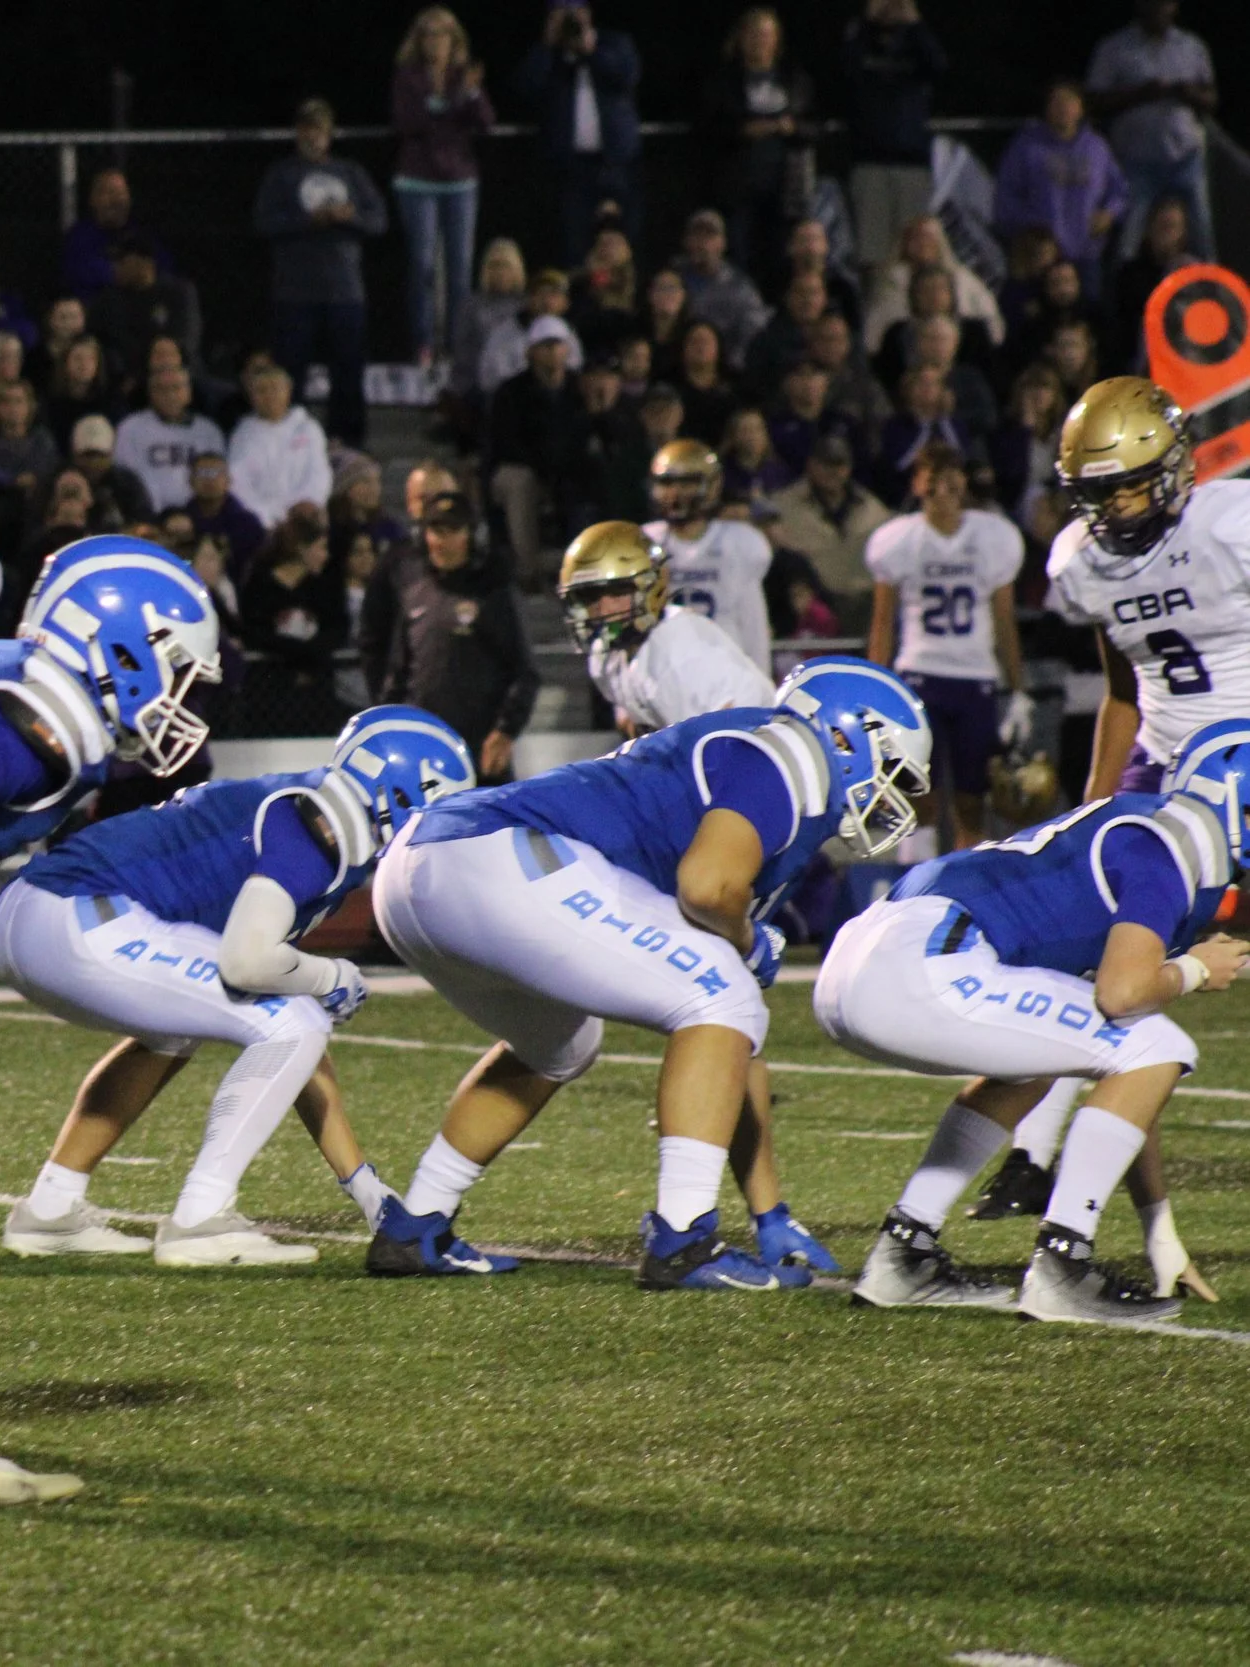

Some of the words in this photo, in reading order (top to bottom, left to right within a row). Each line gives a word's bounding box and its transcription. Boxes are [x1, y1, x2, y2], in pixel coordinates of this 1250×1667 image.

[921, 586, 976, 635] 20
[1113, 587, 1196, 625] CBA
[1146, 628, 1213, 696] 8
[561, 889, 732, 997] BISON
